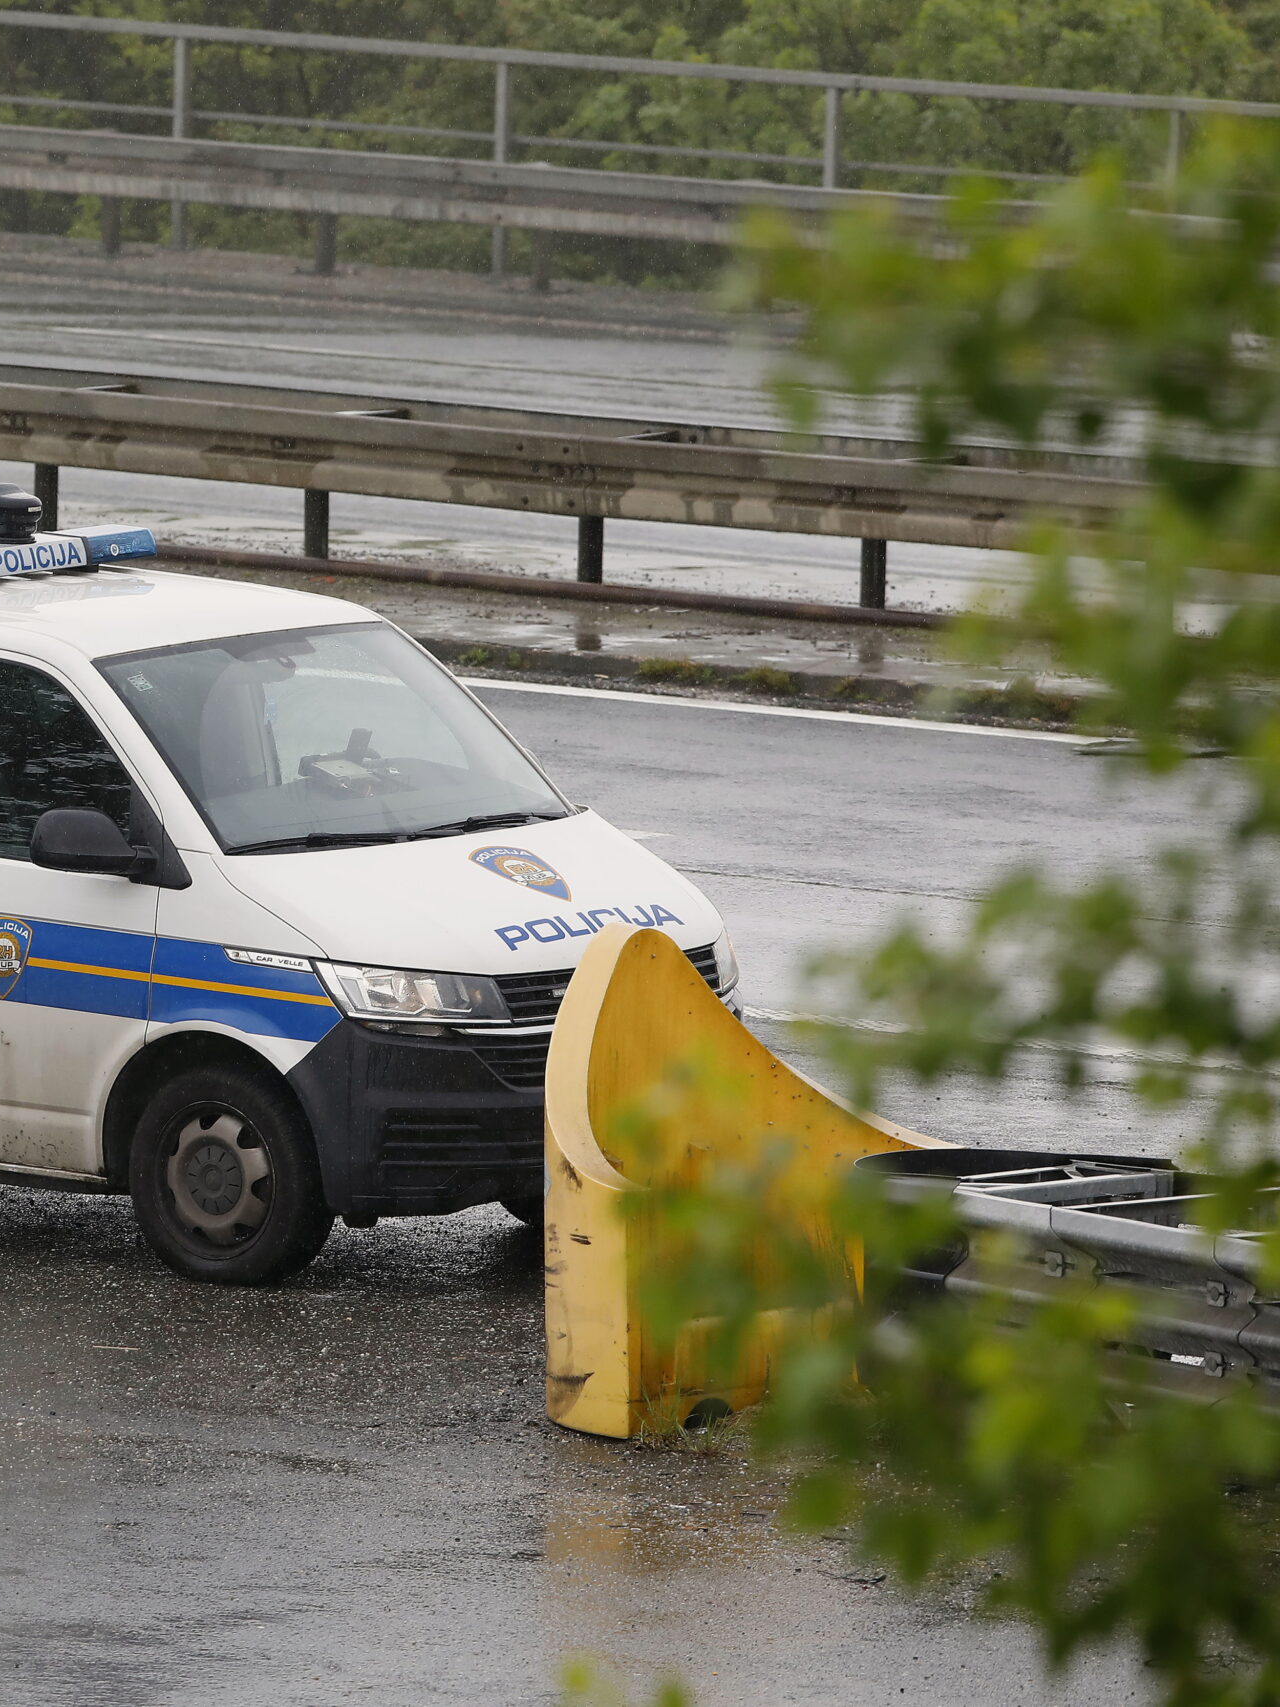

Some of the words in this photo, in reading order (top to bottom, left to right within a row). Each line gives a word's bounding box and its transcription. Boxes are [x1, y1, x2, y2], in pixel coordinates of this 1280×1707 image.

[475, 848, 533, 864] POLICIJA
[494, 904, 686, 951] POLICIJA
[277, 958, 304, 967] VELLE
